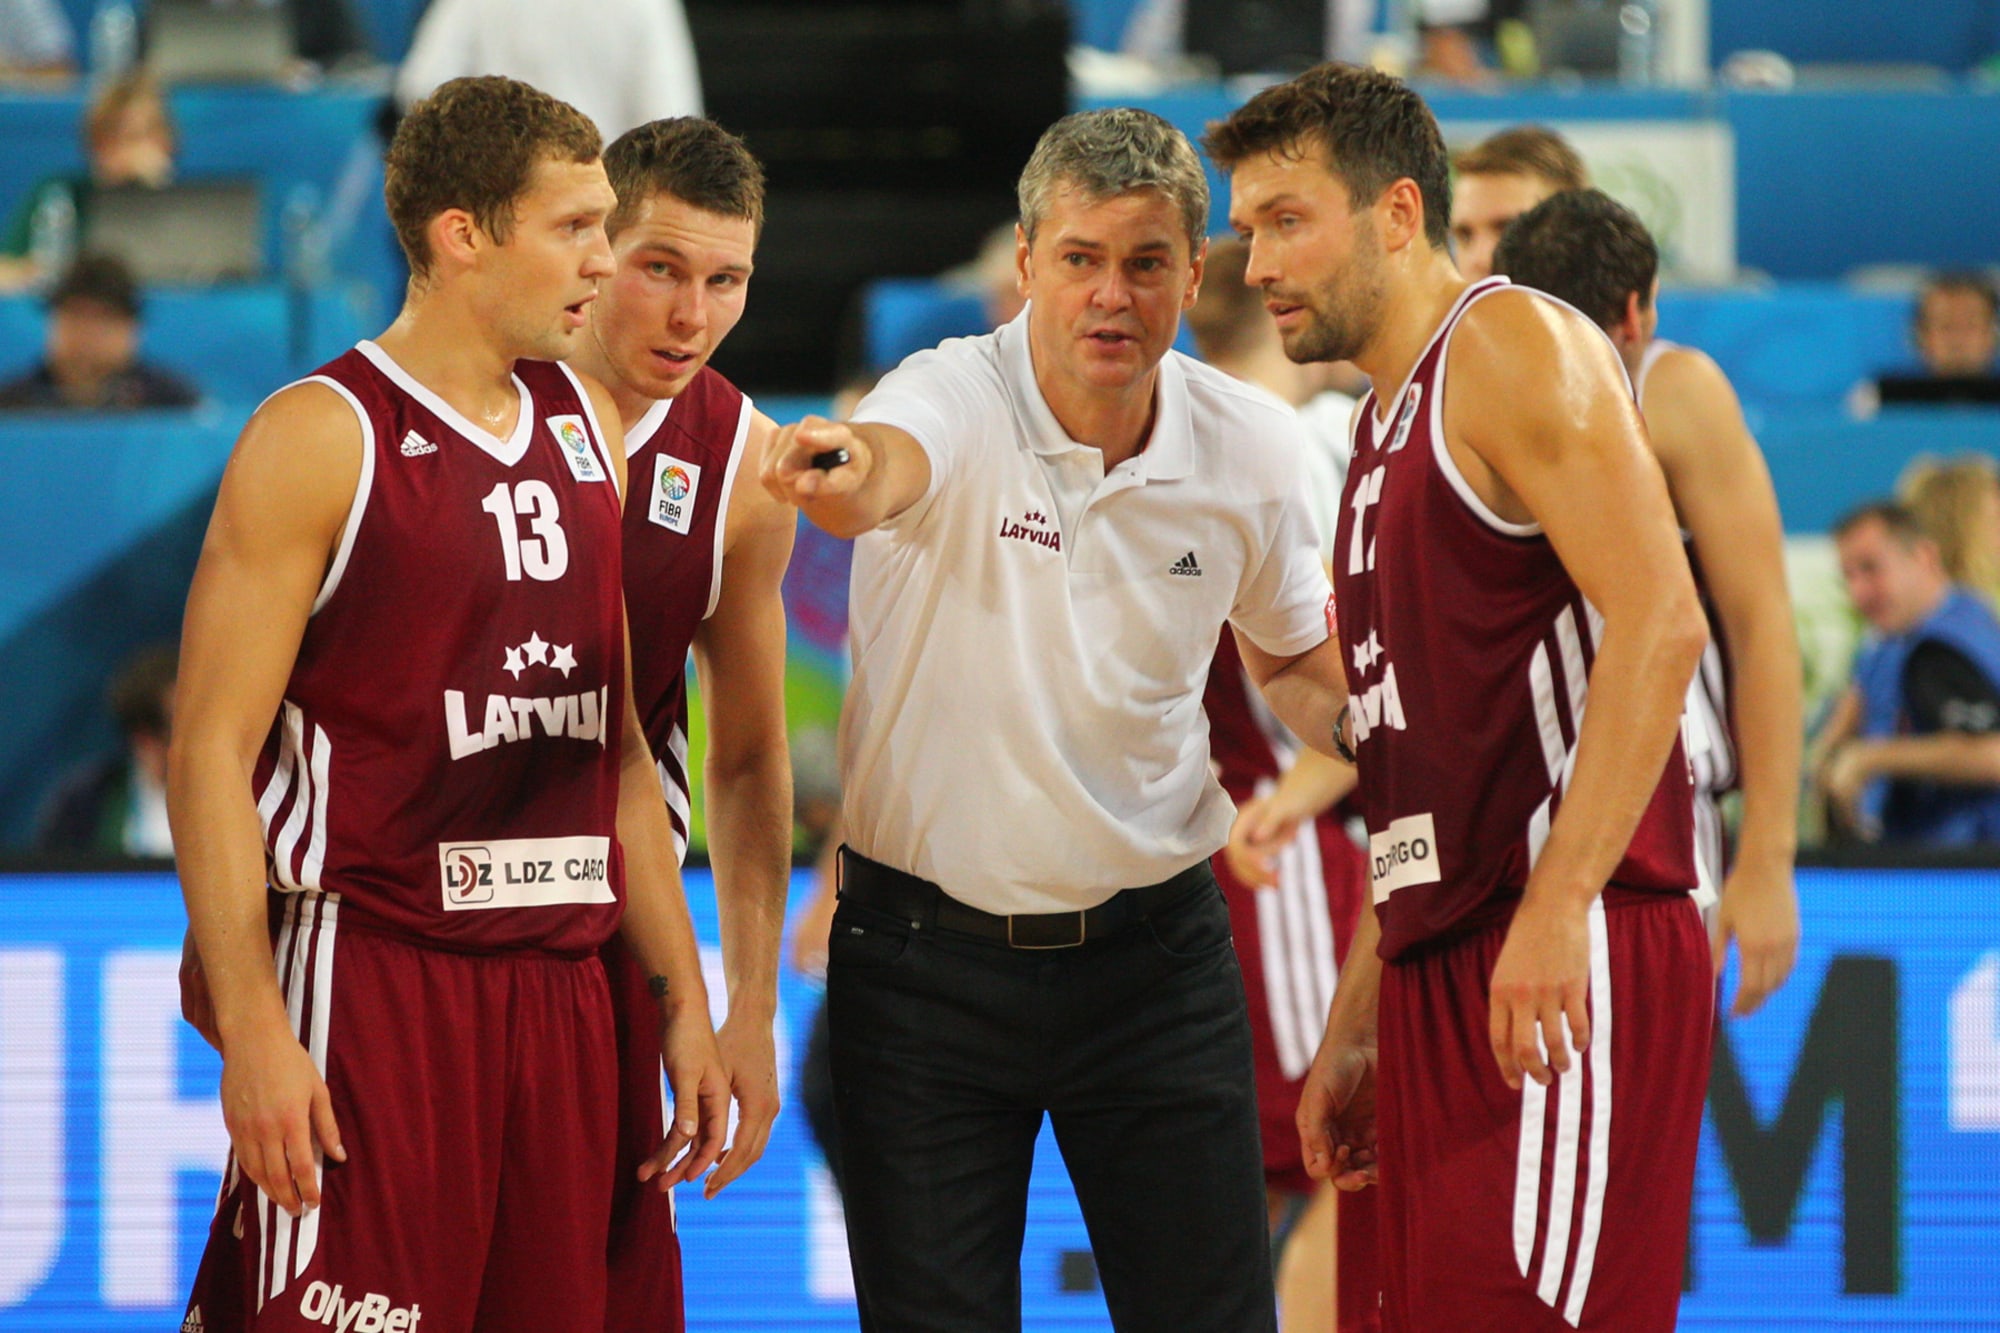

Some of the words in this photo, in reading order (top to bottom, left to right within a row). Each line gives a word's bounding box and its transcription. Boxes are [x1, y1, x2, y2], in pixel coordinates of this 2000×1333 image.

[659, 500, 682, 519] FIBA
[481, 480, 569, 581] 13
[1000, 518, 1061, 552] LATVIJA
[1169, 566, 1202, 577] adidas
[504, 861, 555, 884] LDZ
[299, 1280, 422, 1333] OlyBet
